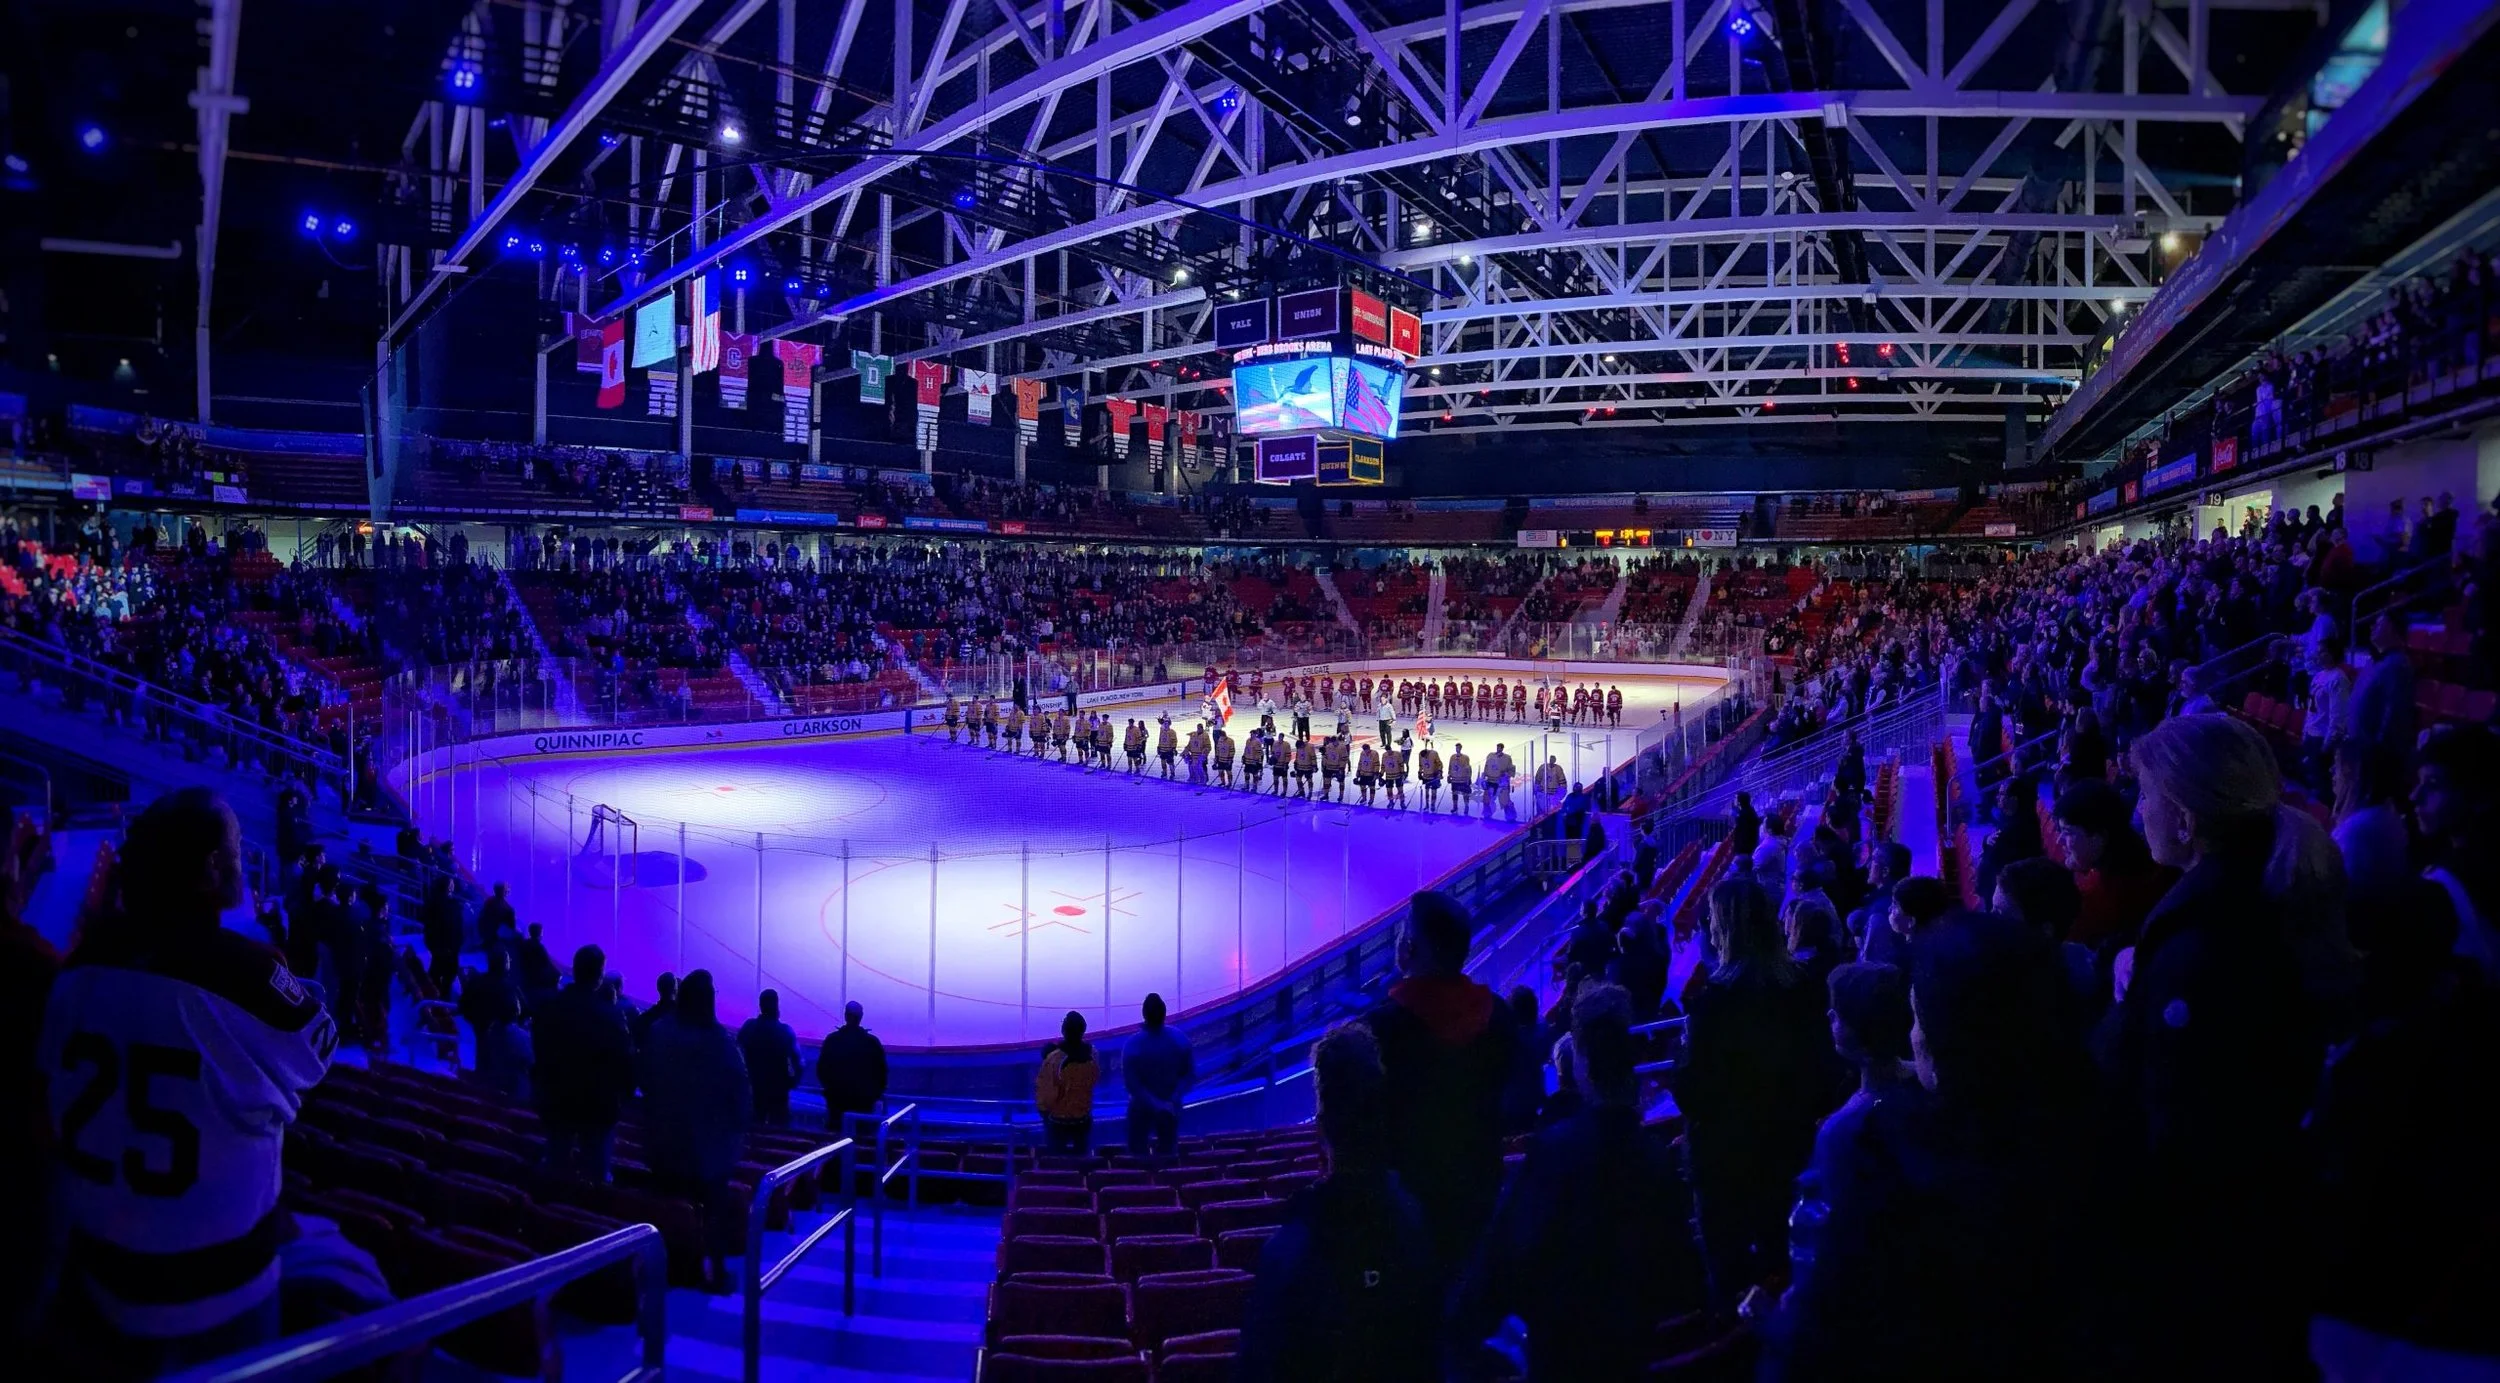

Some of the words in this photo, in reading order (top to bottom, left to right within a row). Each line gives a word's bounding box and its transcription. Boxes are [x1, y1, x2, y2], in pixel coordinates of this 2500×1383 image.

[1294, 308, 1322, 320] UNION
[1230, 319, 1252, 329] YALE
[1305, 342, 1332, 352] ARENA
[1356, 344, 1373, 355] LAKE
[868, 366, 879, 385] D
[926, 377, 934, 389] H
[1270, 452, 1306, 463] COLGATE
[2336, 451, 2346, 470] 18
[2209, 493, 2221, 505] 19
[1695, 531, 1701, 541] I
[1713, 531, 1735, 541] NY
[783, 718, 862, 736] CLARKSON
[534, 732, 644, 753] QUINNIPIAC
[60, 1031, 201, 1198] 25
